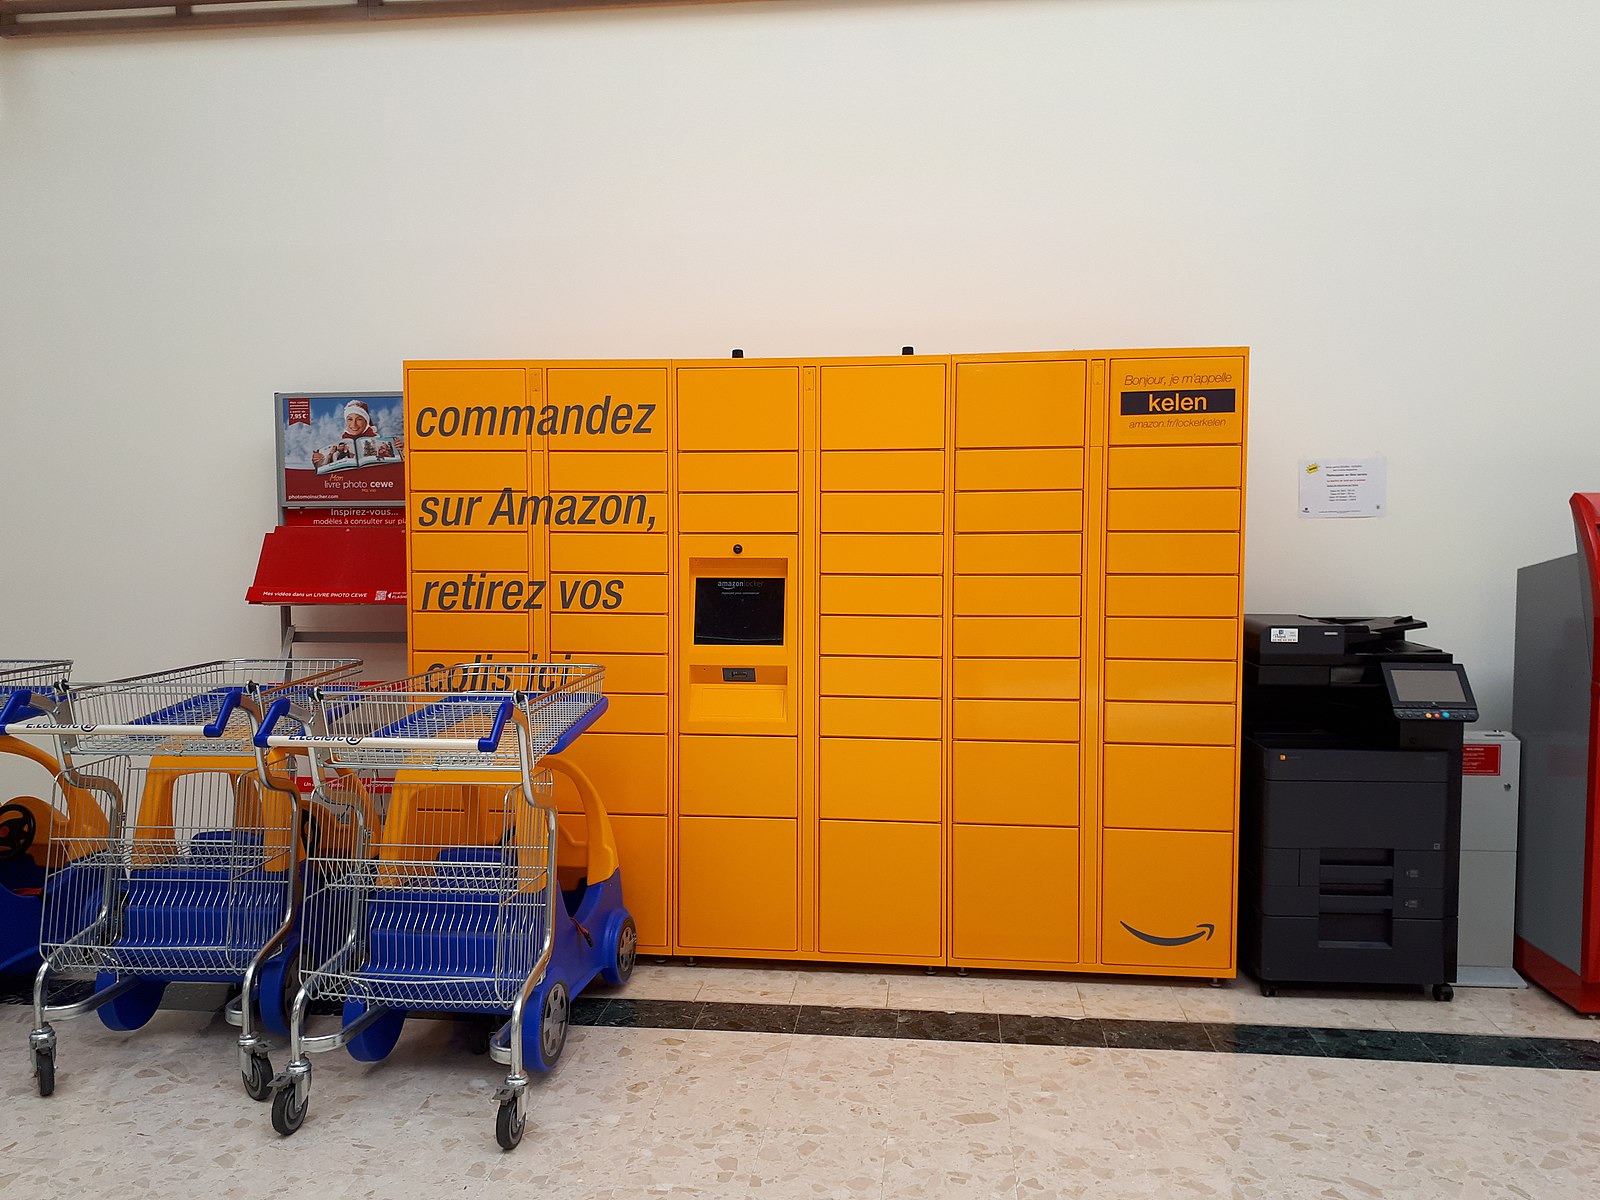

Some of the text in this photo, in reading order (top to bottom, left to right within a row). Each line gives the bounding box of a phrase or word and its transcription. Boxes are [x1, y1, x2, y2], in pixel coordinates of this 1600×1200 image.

[1124, 372, 1232, 387] Bonjour, je m'appelle
[1149, 393, 1207, 412] kelen
[416, 395, 656, 437] commandez
[1128, 418, 1226, 429] amazon.fr/lockerkelen
[324, 481, 341, 489] livre
[343, 480, 368, 490] photo
[330, 508, 399, 517] Inspirez-vous...
[418, 487, 656, 532] sur Amazon,
[421, 572, 625, 610] retirez vos
[424, 654, 571, 691] colis ici
